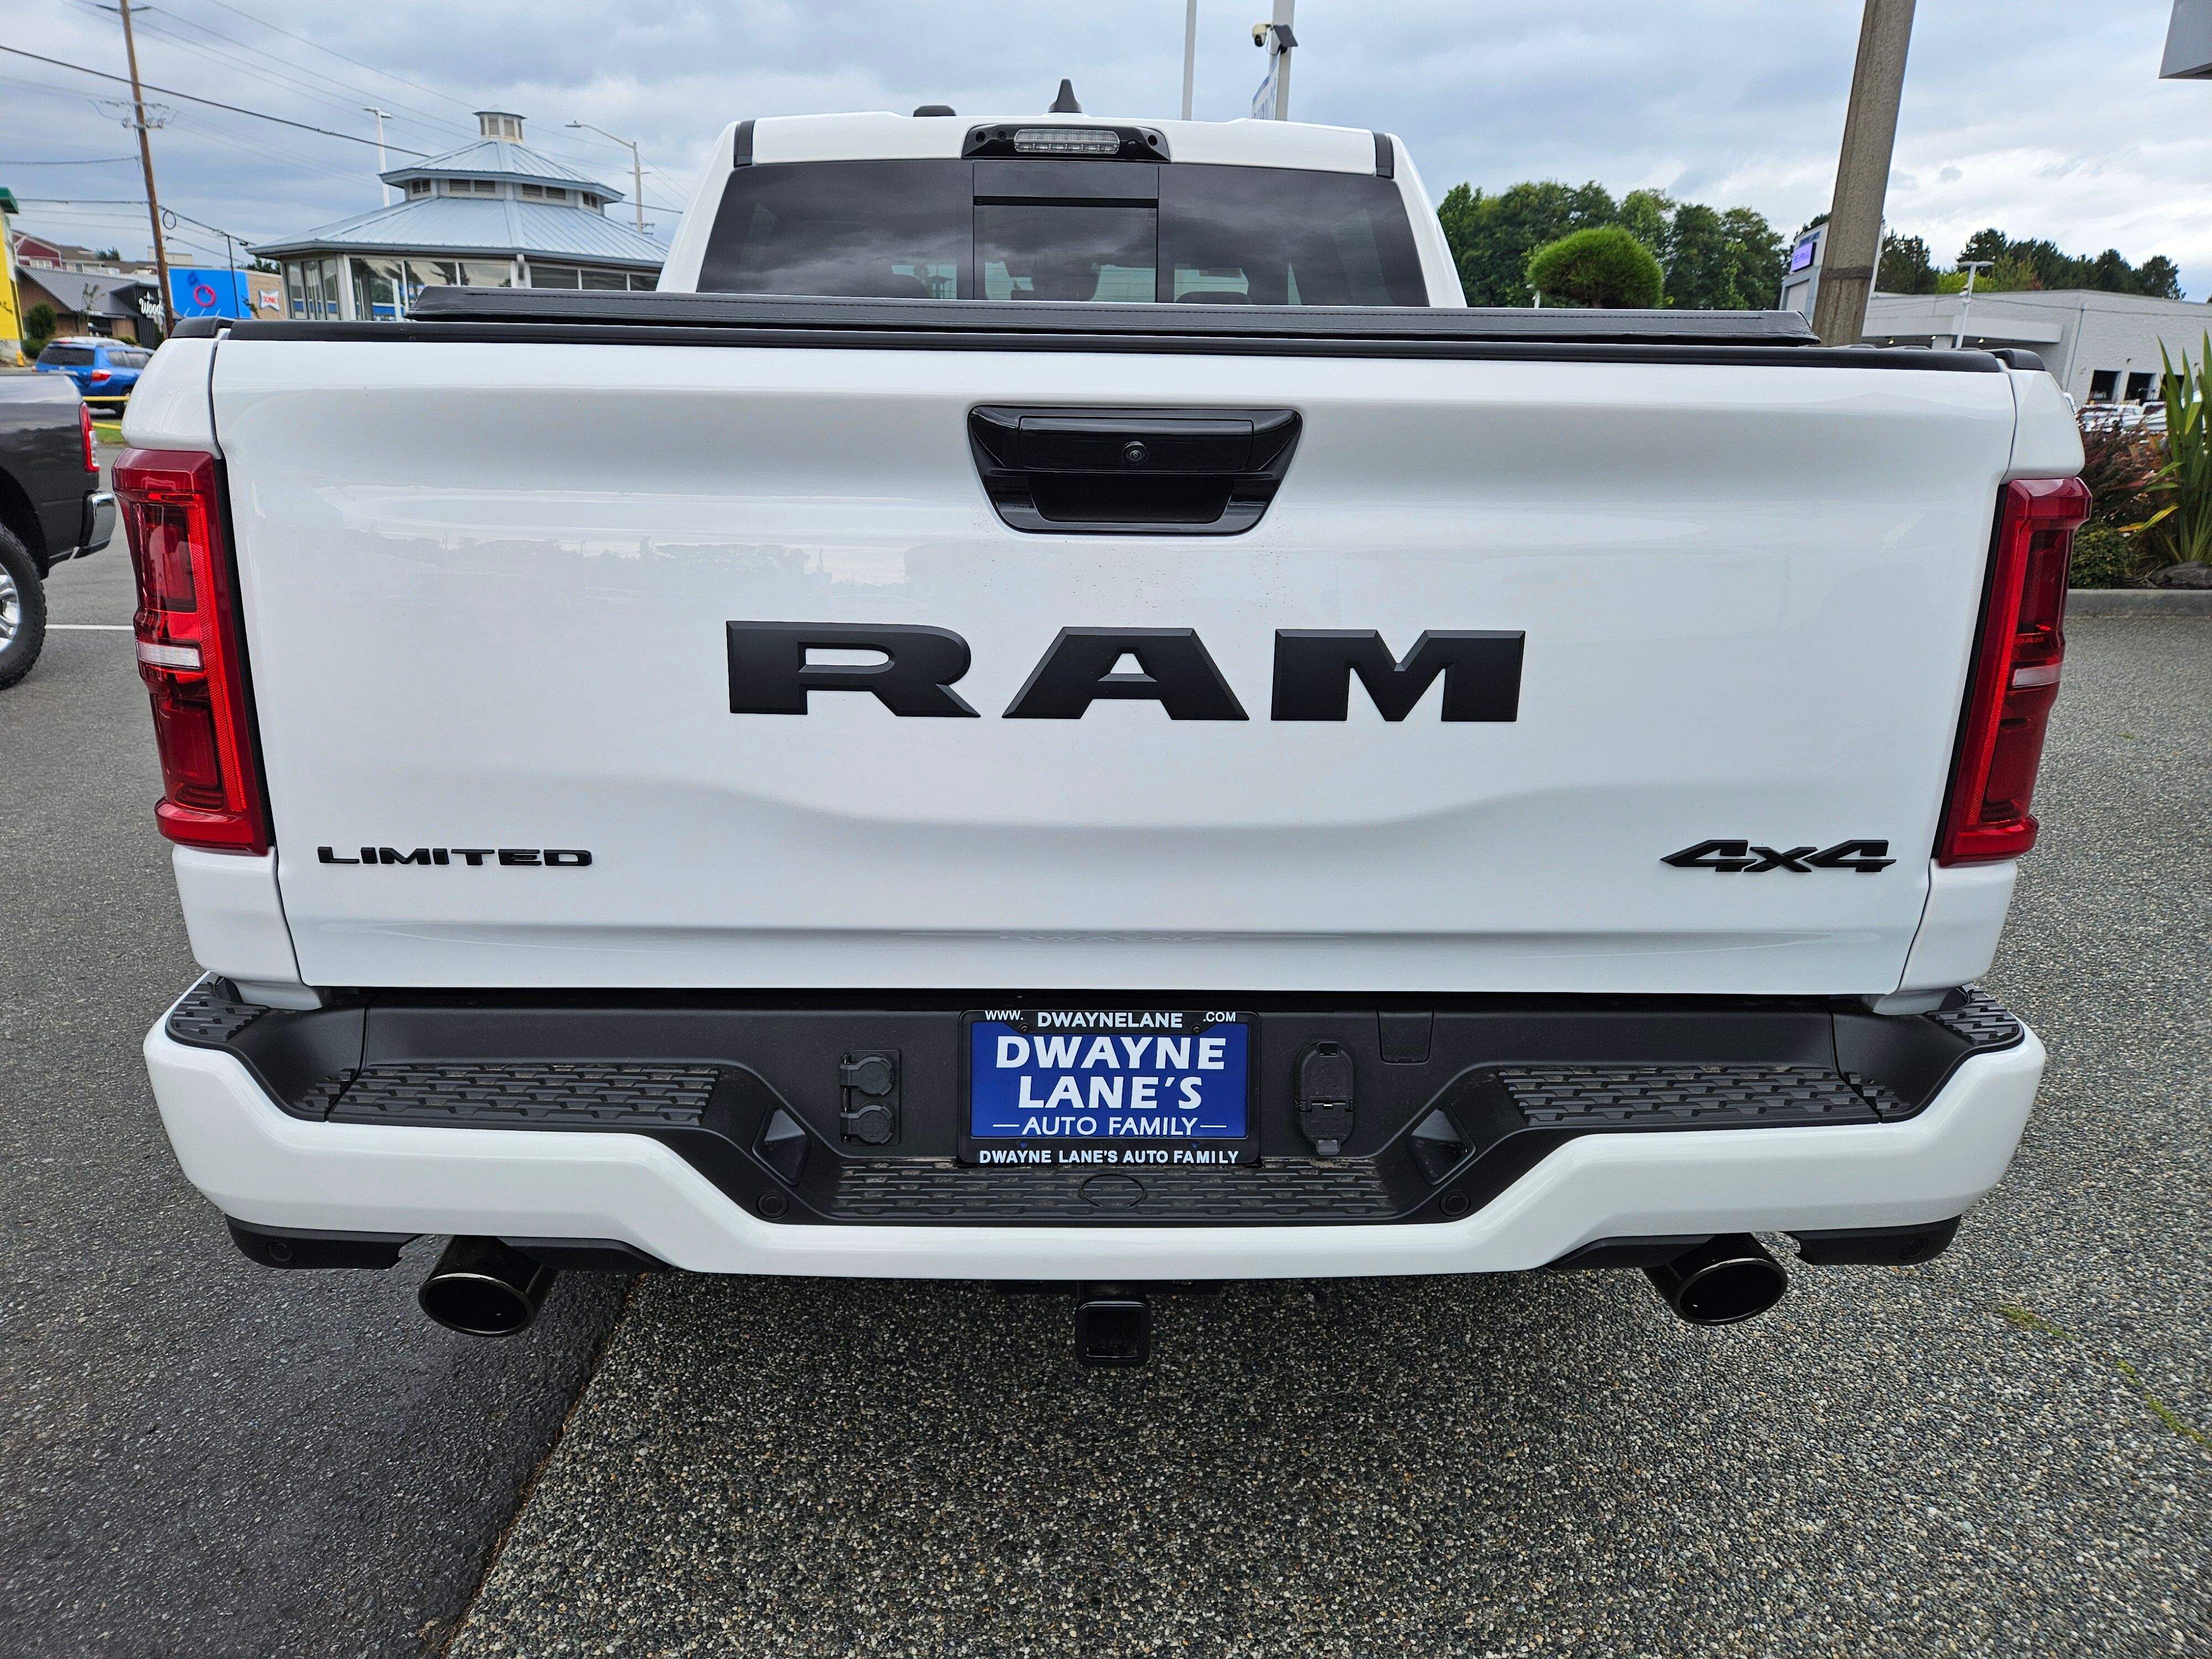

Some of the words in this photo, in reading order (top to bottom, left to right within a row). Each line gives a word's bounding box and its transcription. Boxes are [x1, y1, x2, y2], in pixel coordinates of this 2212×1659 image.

[726, 620, 1526, 722] RAM
[317, 846, 592, 867] LIMITED
[1660, 839, 1897, 873] 4x4
[1037, 1012, 1183, 1027] DWAYNELANE
[996, 1036, 1227, 1070] DWAYNE
[1018, 1076, 1202, 1109] LANE'S
[1021, 1116, 1097, 1135] AUTO
[1108, 1117, 1198, 1136] FAMILY
[979, 1150, 1052, 1164] DWAYNE
[1059, 1150, 1118, 1164] LANE'S
[1122, 1150, 1168, 1164] AUTO
[1173, 1150, 1239, 1164] FAMILY
